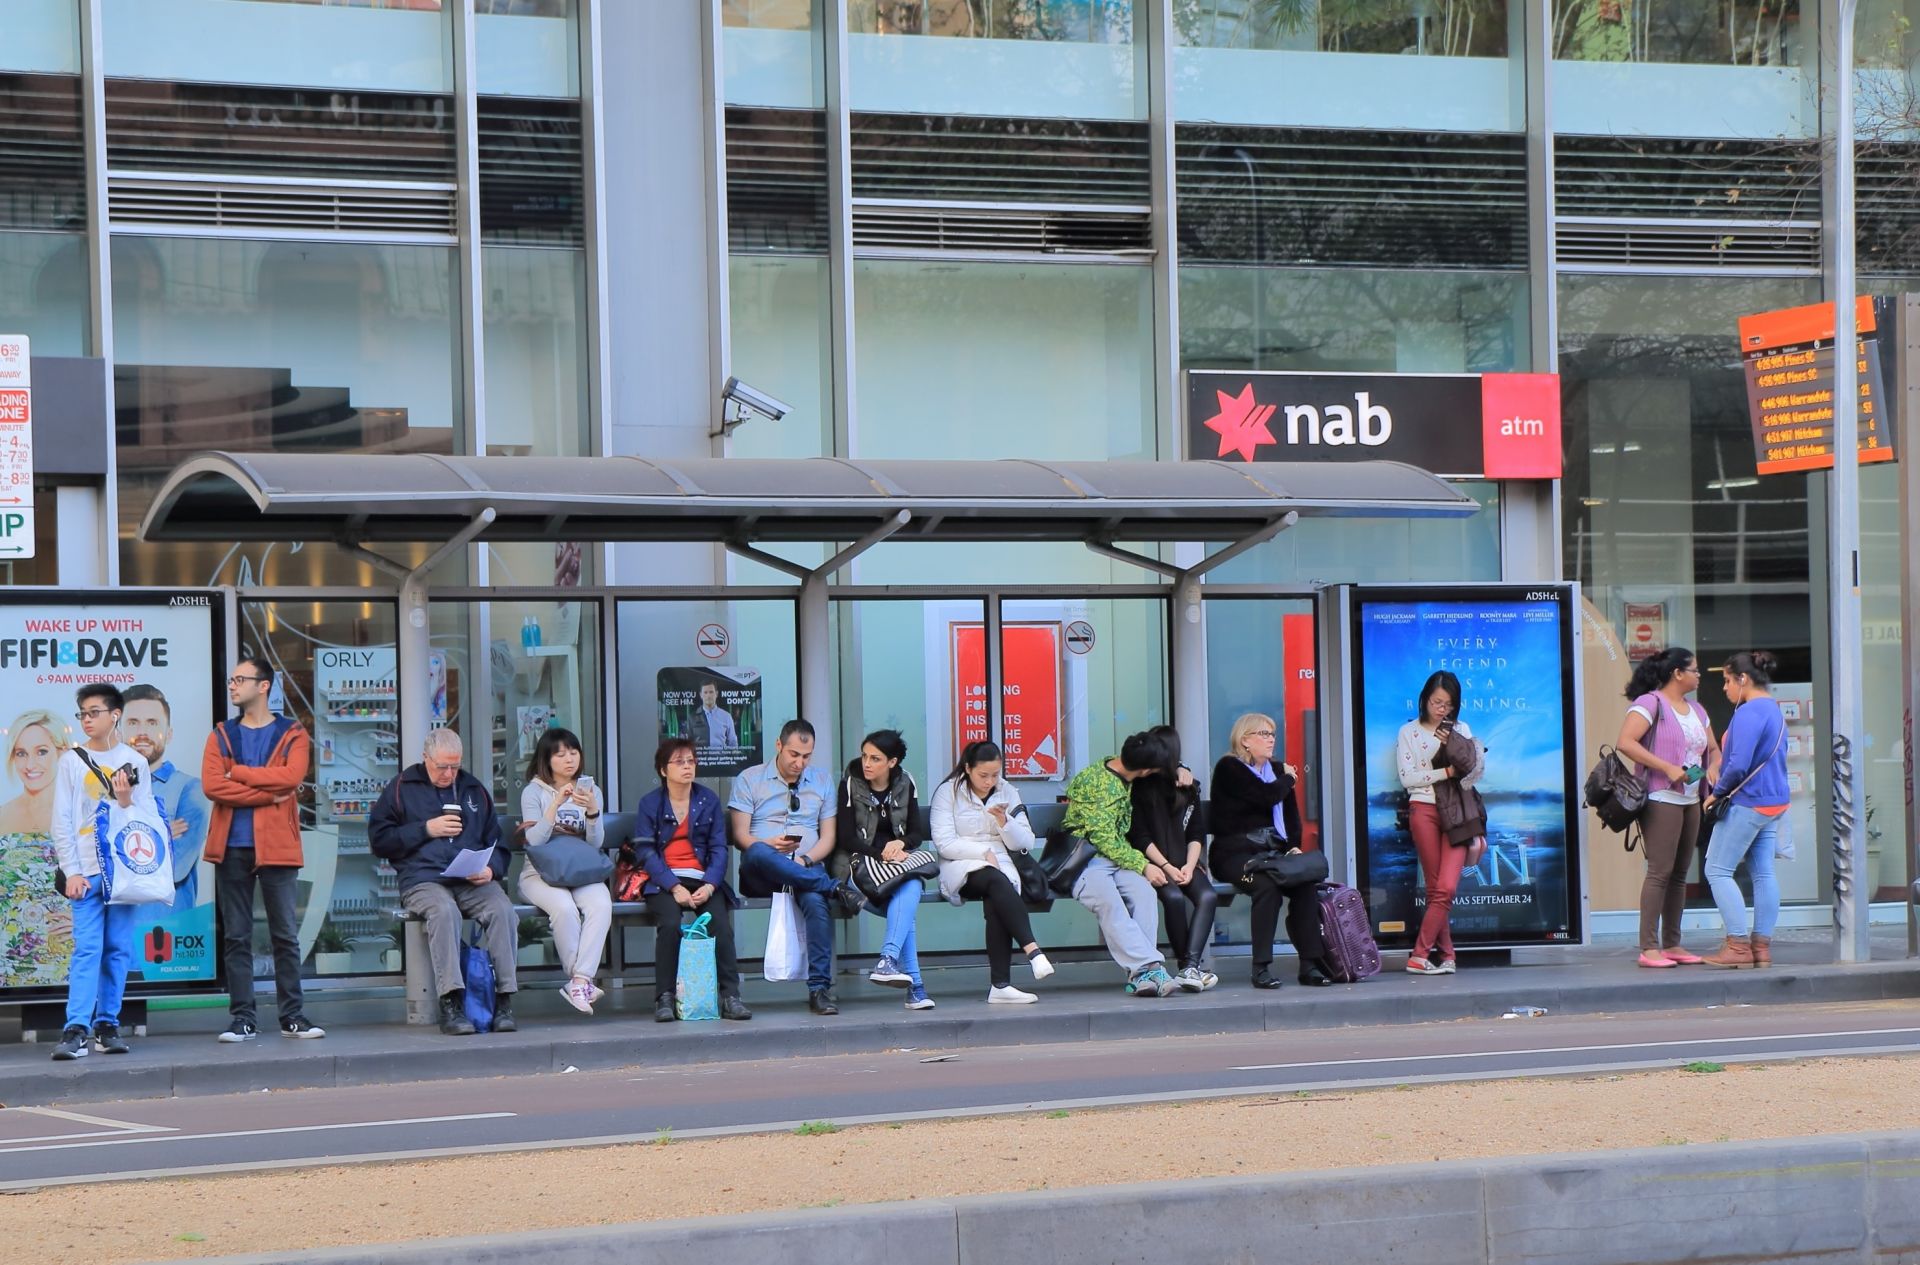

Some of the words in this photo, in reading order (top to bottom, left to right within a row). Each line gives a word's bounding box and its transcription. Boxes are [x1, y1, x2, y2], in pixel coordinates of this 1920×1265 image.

[0, 394, 28, 406] DING
[1284, 392, 1392, 446] nab
[1501, 416, 1544, 436] atm
[170, 597, 211, 606] ADSHEL
[26, 620, 70, 632] WAKE
[76, 620, 97, 632] UP
[102, 620, 142, 632] WITH
[1438, 638, 1497, 649] EVERY
[322, 652, 374, 668] ORLY
[1428, 658, 1507, 670] LEGEND
[37, 674, 72, 684] 6-9AM
[76, 673, 134, 684] WEEKDAYS
[1299, 668, 1314, 679] re
[1487, 679, 1494, 688] A
[966, 730, 987, 740] INT
[1415, 898, 1425, 906] IN
[1472, 895, 1520, 905] SEPTEMBER
[1520, 895, 1532, 903] 24
[175, 936, 204, 949] FOX
